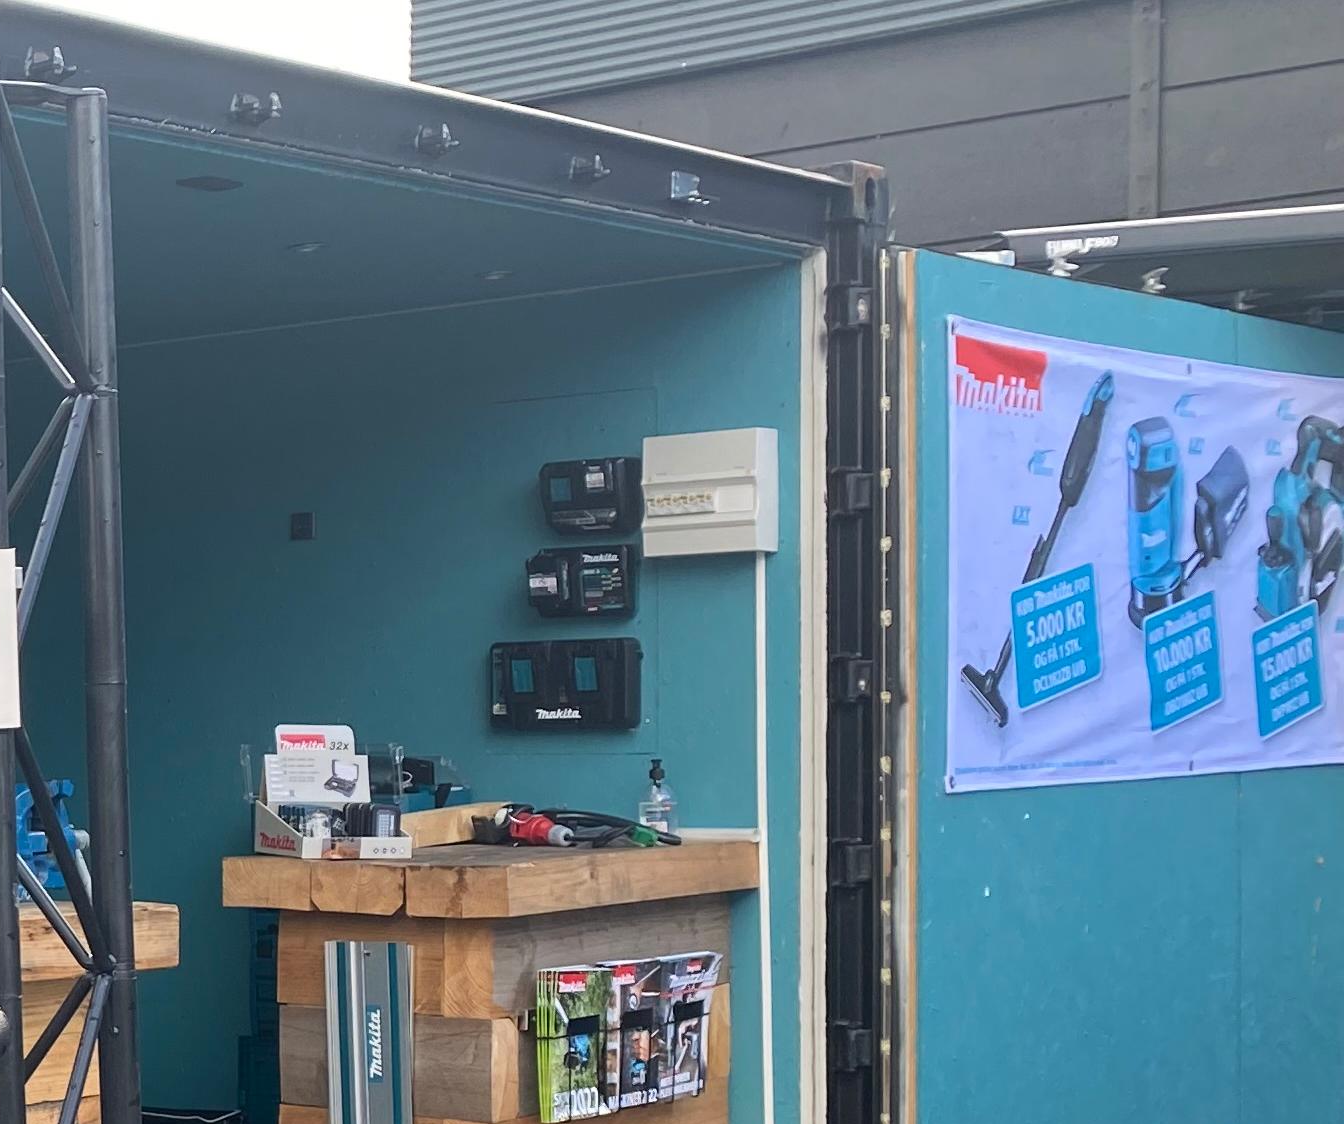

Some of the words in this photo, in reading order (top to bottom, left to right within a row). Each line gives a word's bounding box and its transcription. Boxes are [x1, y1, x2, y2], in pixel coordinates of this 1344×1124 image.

[955, 364, 1043, 413] Makita
[583, 554, 619, 563] Makita
[1026, 610, 1065, 648] 5.000
[1065, 601, 1086, 632] KR
[1034, 651, 1047, 669] OG
[1047, 642, 1059, 662] FÅ
[535, 707, 581, 720] Makita
[280, 739, 326, 750] Makita
[329, 741, 349, 750] 32x
[260, 832, 296, 851] Makita
[368, 1008, 382, 1082] Makita
